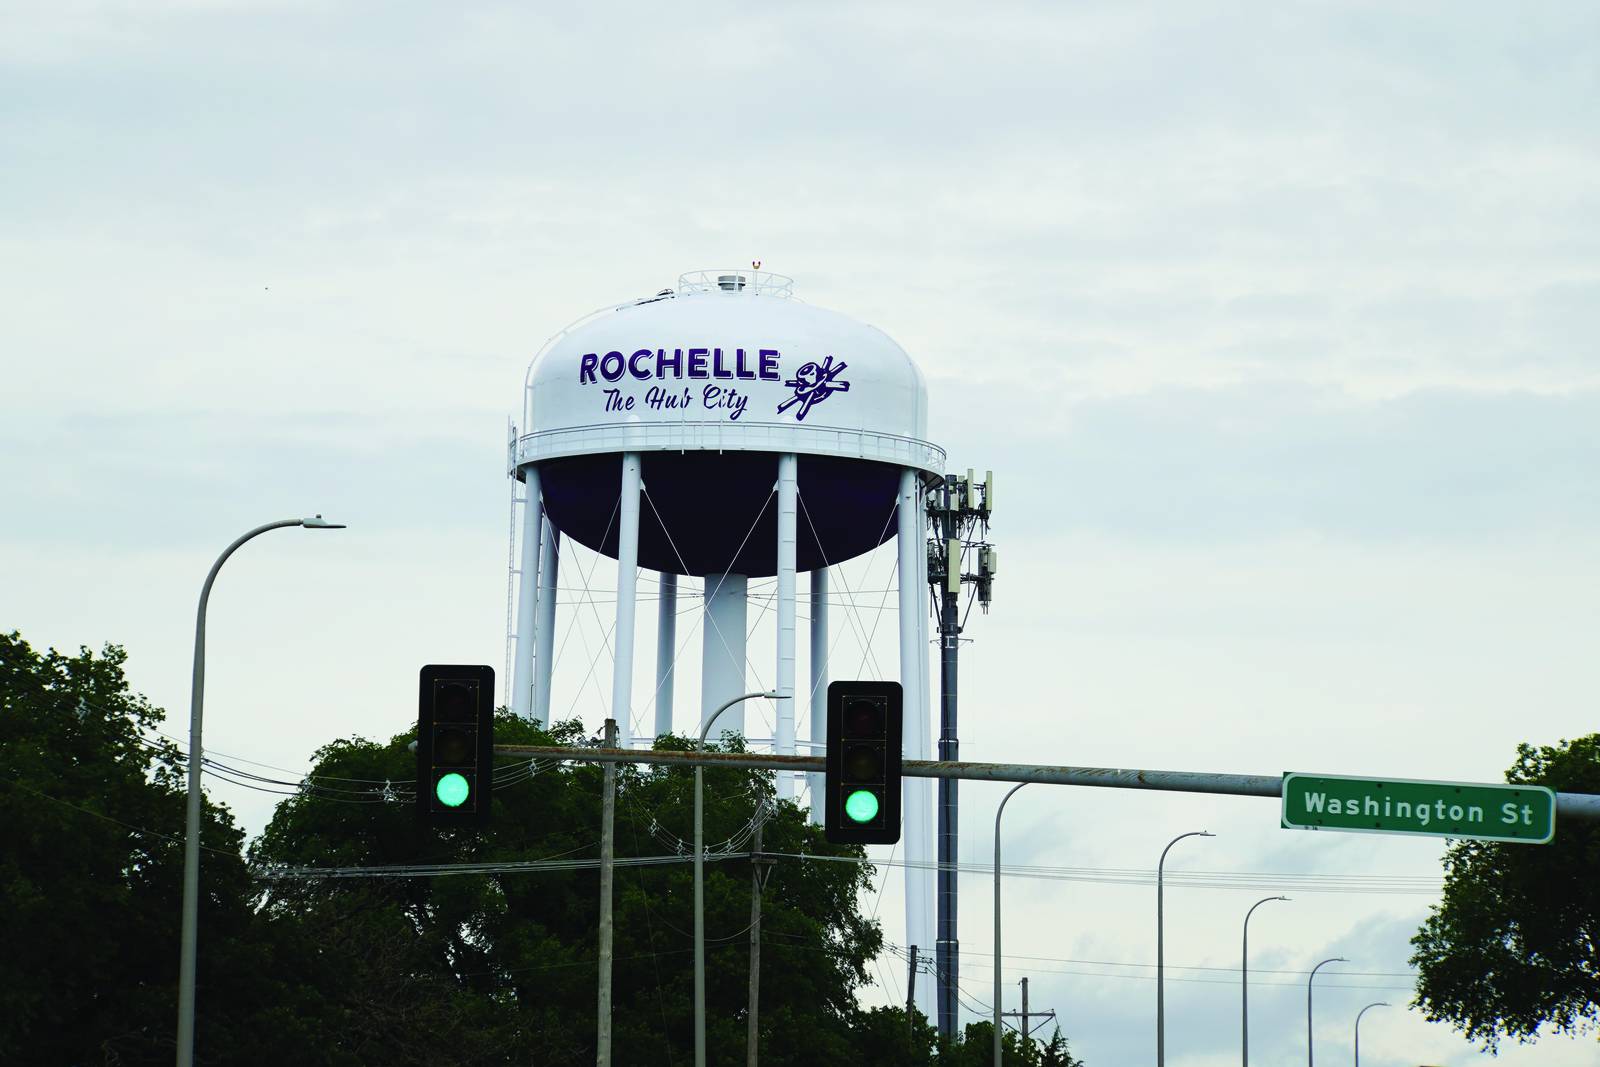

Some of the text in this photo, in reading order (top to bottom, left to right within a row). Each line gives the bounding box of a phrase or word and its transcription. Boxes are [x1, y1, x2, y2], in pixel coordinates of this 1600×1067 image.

[579, 348, 781, 385] ROCHELLE
[602, 383, 749, 421] The Hub City
[1304, 791, 1533, 826] Washington St
